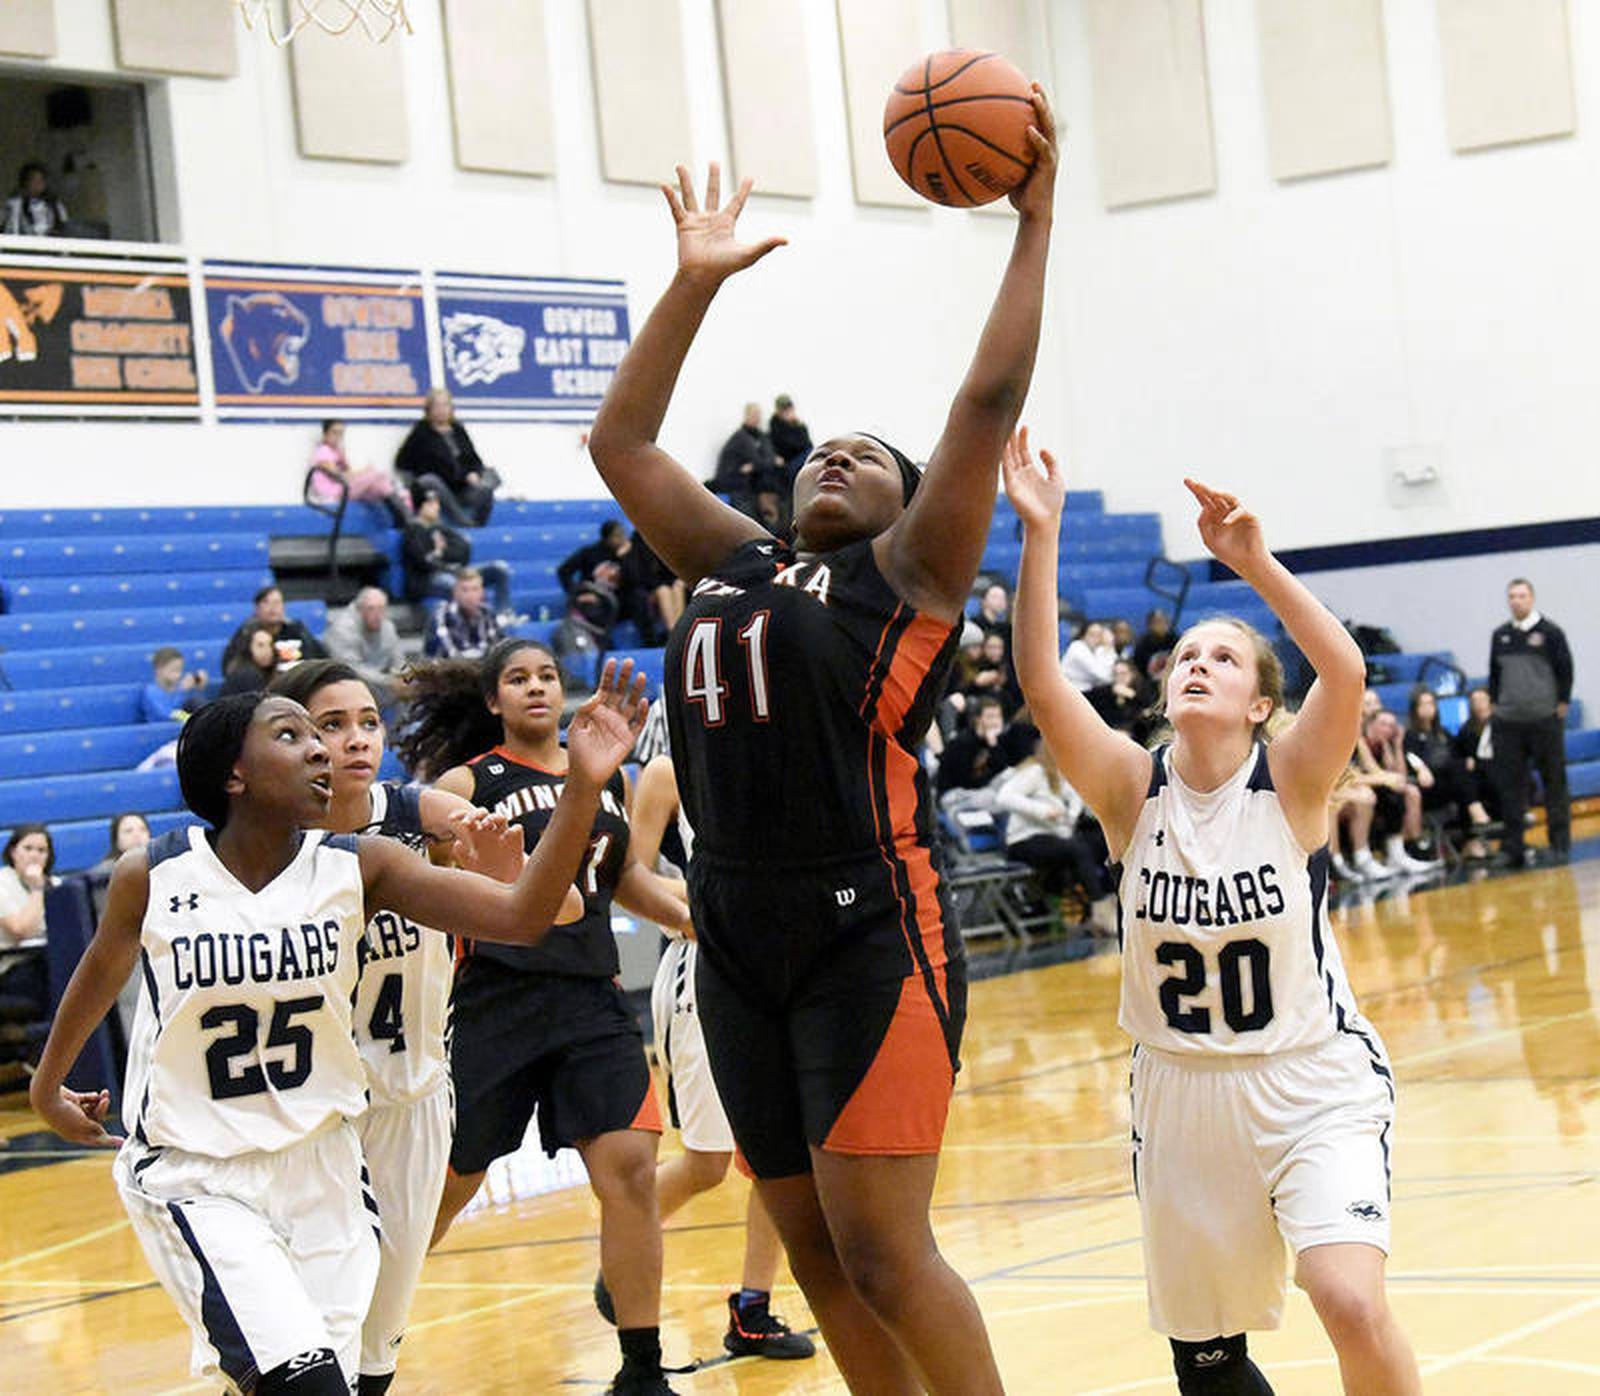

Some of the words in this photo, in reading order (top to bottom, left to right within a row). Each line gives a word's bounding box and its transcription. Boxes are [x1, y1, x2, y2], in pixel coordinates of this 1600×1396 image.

[683, 608, 771, 728] 41
[171, 919, 340, 990] COUGARS
[1155, 938, 1274, 1034] 20
[200, 995, 325, 1100] 25
